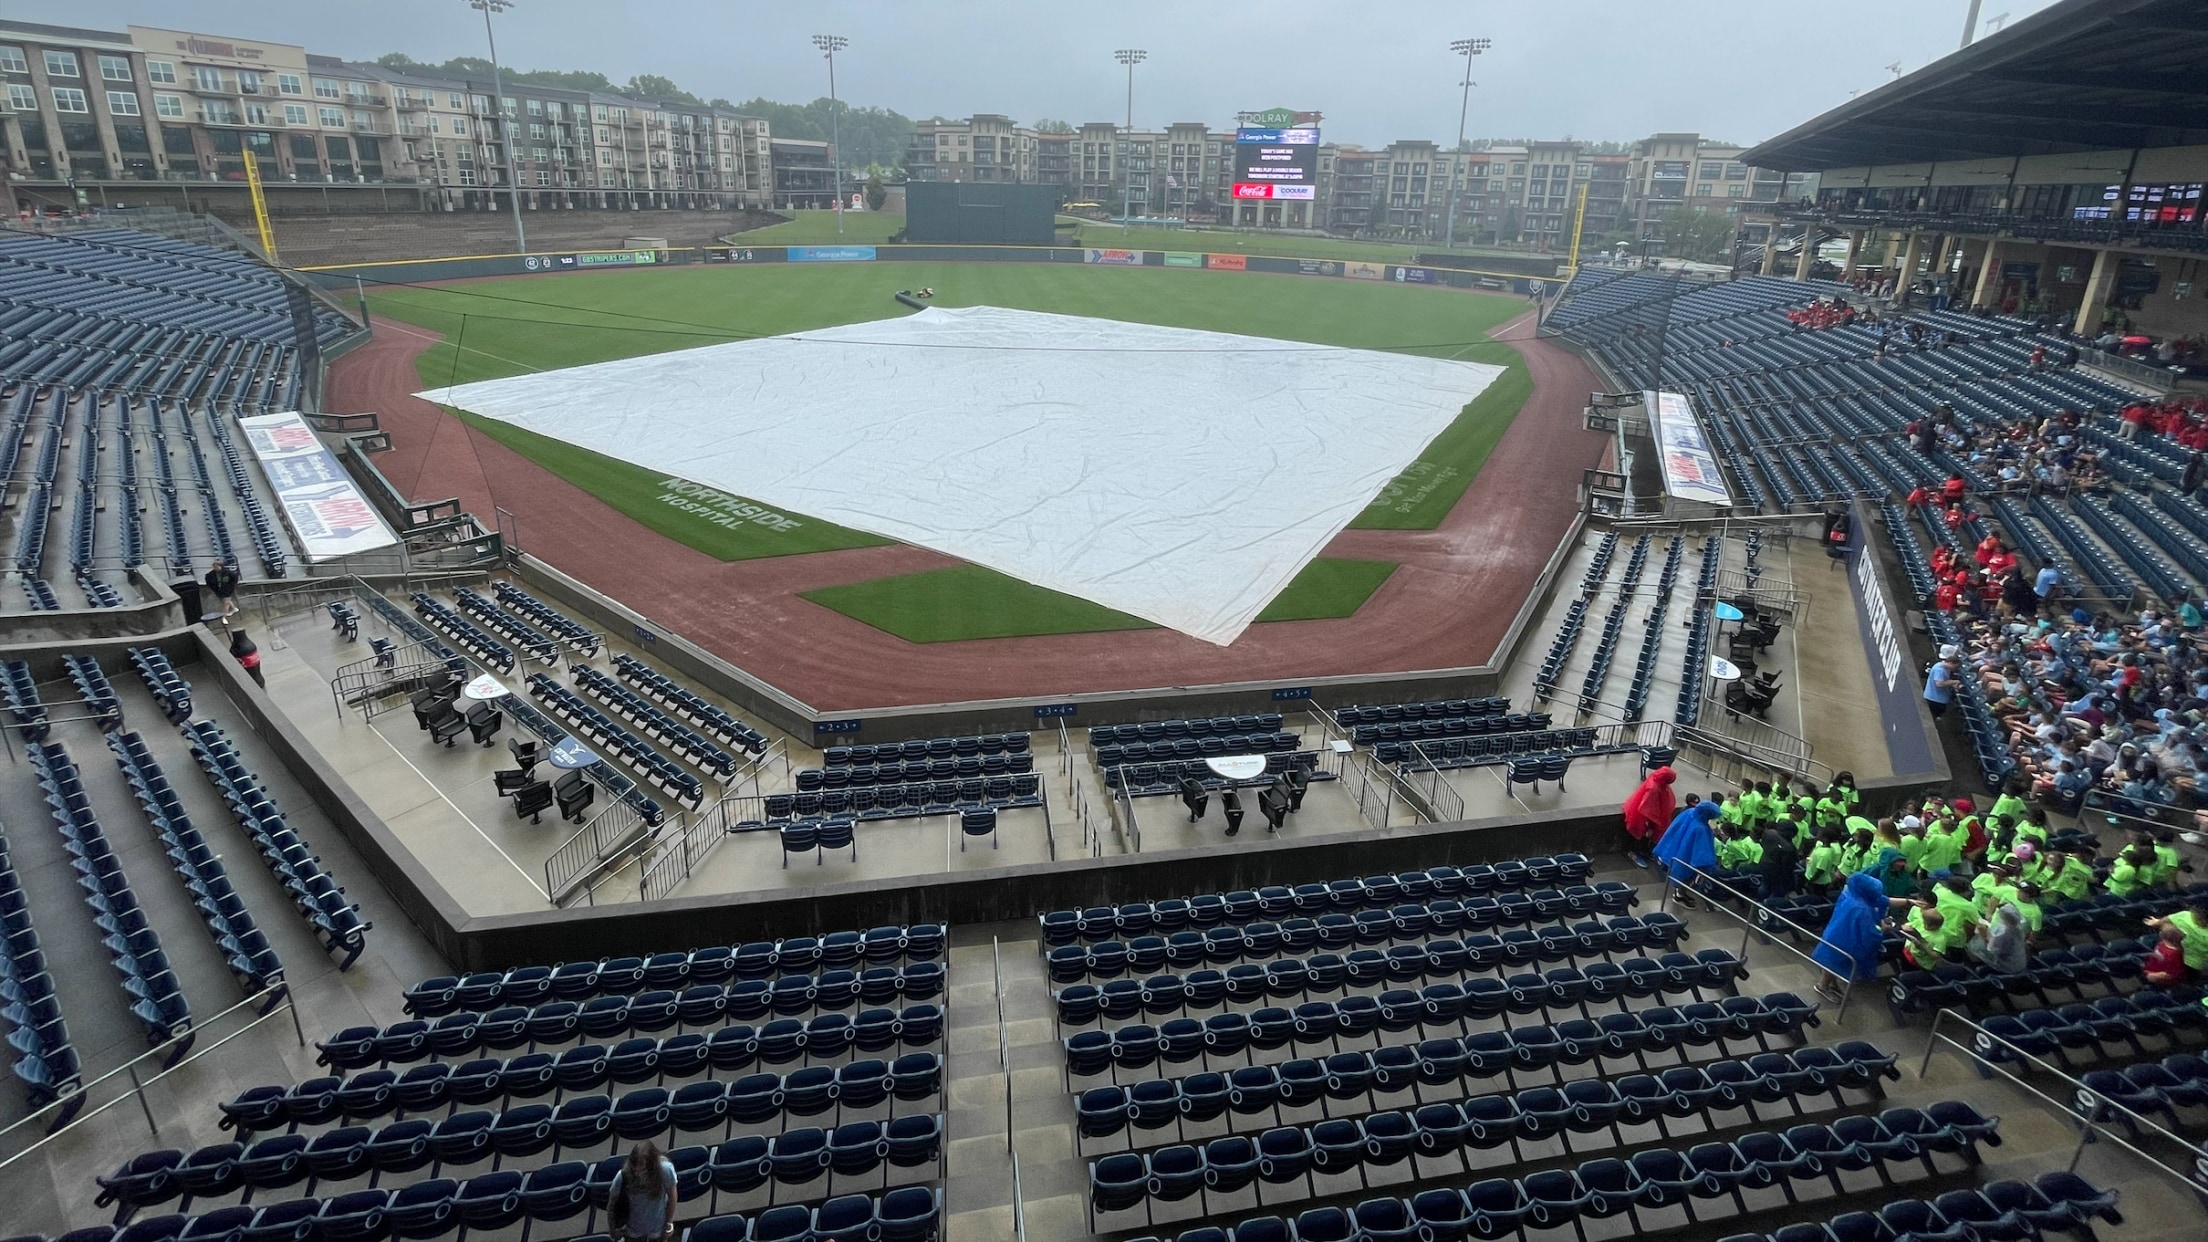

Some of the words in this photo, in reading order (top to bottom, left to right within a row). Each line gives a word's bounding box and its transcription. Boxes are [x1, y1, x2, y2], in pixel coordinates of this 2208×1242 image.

[1237, 113, 1289, 123] COOLRAY
[1239, 185, 1267, 196] Coca-Cola
[656, 493, 744, 530] HOSPITAL
[657, 477, 803, 533] NORTHSIDE
[1879, 617, 1901, 693] CLUB
